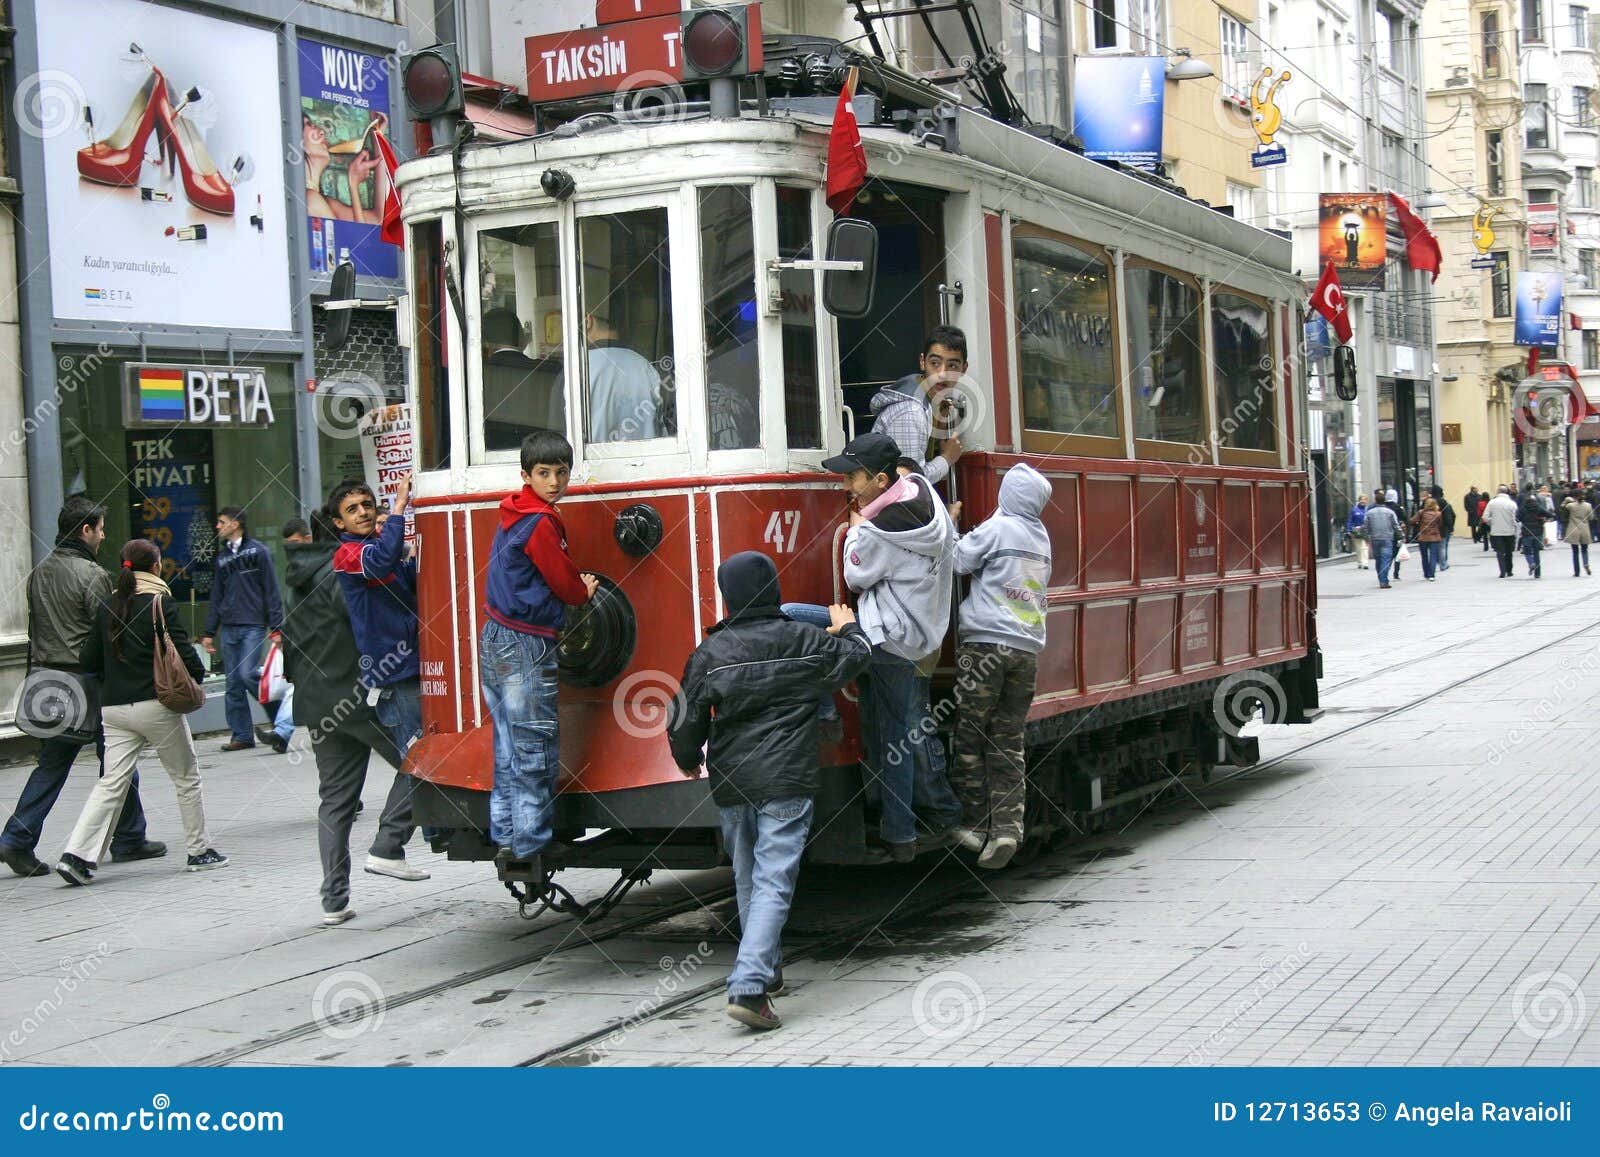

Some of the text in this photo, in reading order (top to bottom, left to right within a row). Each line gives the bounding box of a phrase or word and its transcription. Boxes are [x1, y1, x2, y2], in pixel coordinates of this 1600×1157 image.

[322, 46, 364, 92] WOLY
[101, 288, 132, 302] BETA
[187, 370, 275, 424] BETA
[132, 440, 174, 461] TEK
[142, 497, 171, 521] 59
[764, 510, 800, 553] 47
